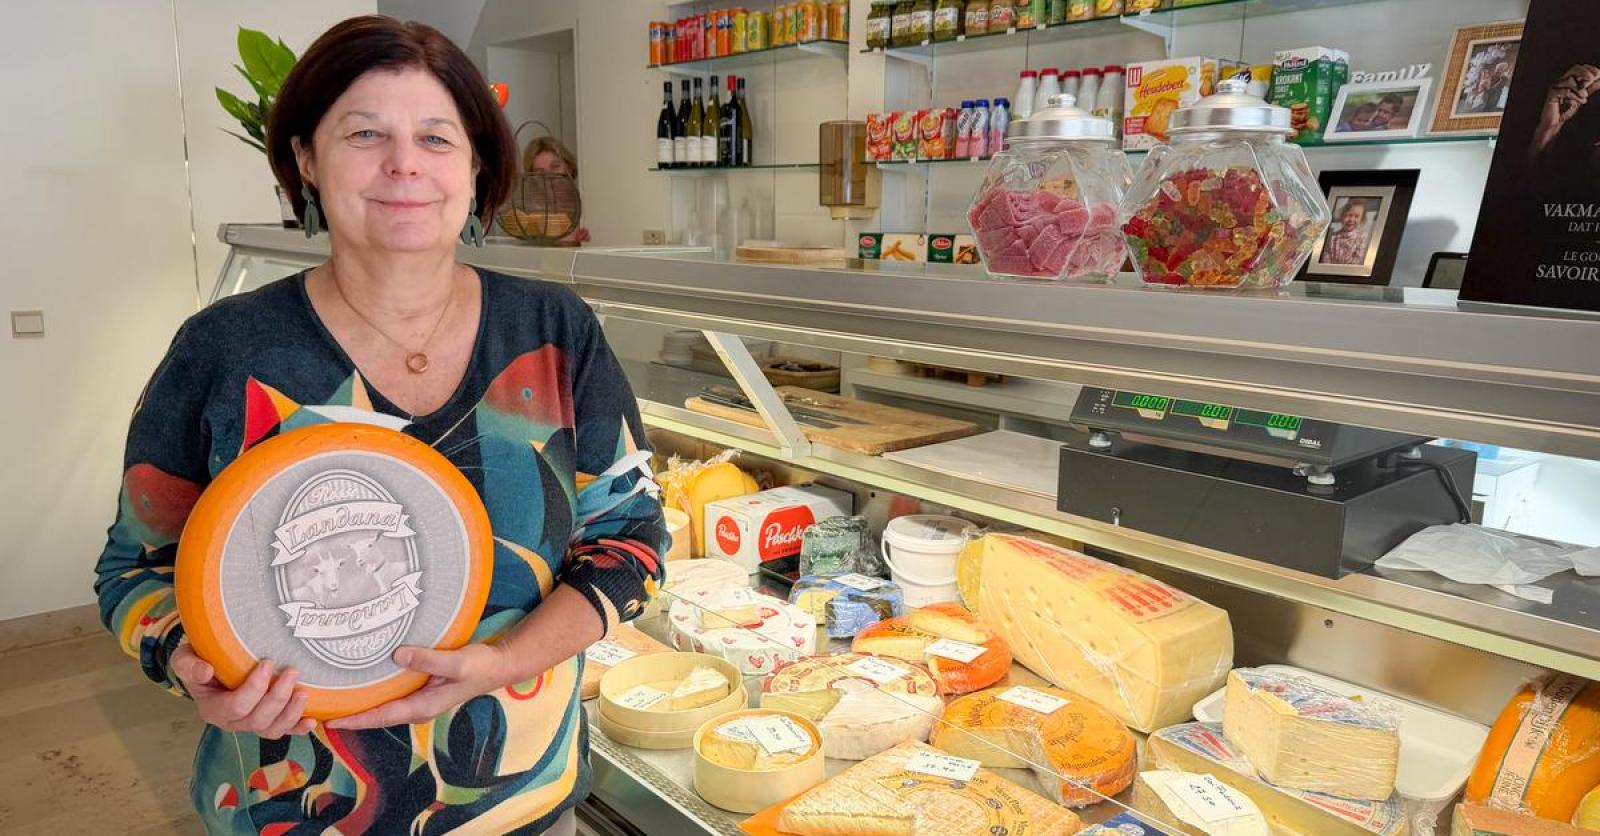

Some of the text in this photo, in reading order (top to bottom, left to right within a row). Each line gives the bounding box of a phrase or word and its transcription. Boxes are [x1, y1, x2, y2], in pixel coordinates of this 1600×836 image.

[1352, 64, 1432, 83] Family
[1568, 222, 1594, 232] DAT
[1564, 251, 1600, 262] LE GO
[1536, 264, 1600, 281] SAVOIR
[285, 507, 397, 546] Landana
[301, 591, 410, 630] Landana
